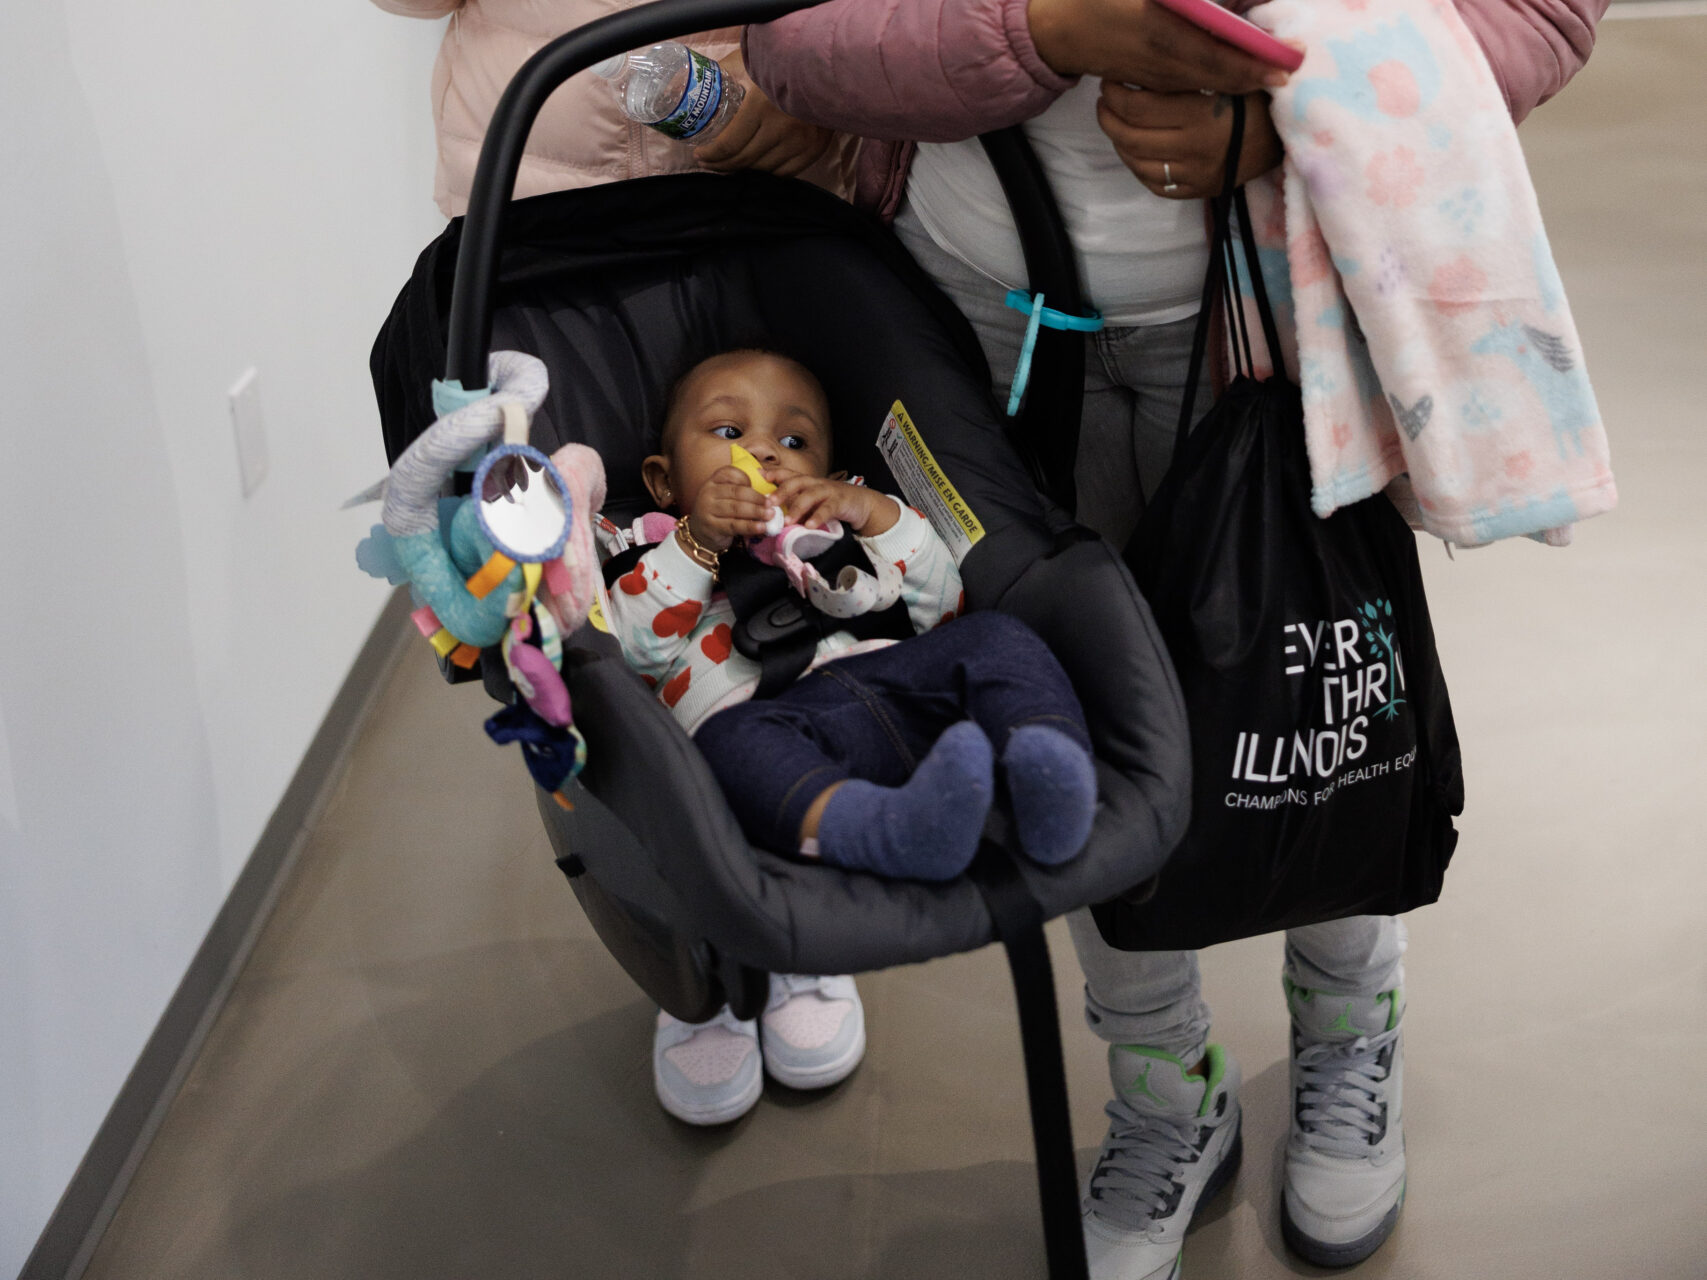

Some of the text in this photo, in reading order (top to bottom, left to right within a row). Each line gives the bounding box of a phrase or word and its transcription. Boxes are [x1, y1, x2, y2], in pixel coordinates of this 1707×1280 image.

[682, 116, 696, 129] ICE
[694, 70, 713, 117] MOUNTAIN
[943, 488, 956, 502] EN
[953, 502, 978, 534] GARDE
[1231, 714, 1369, 783] ILLNOIS
[1313, 782, 1336, 805] FOR
[1337, 761, 1390, 789] HEALTH
